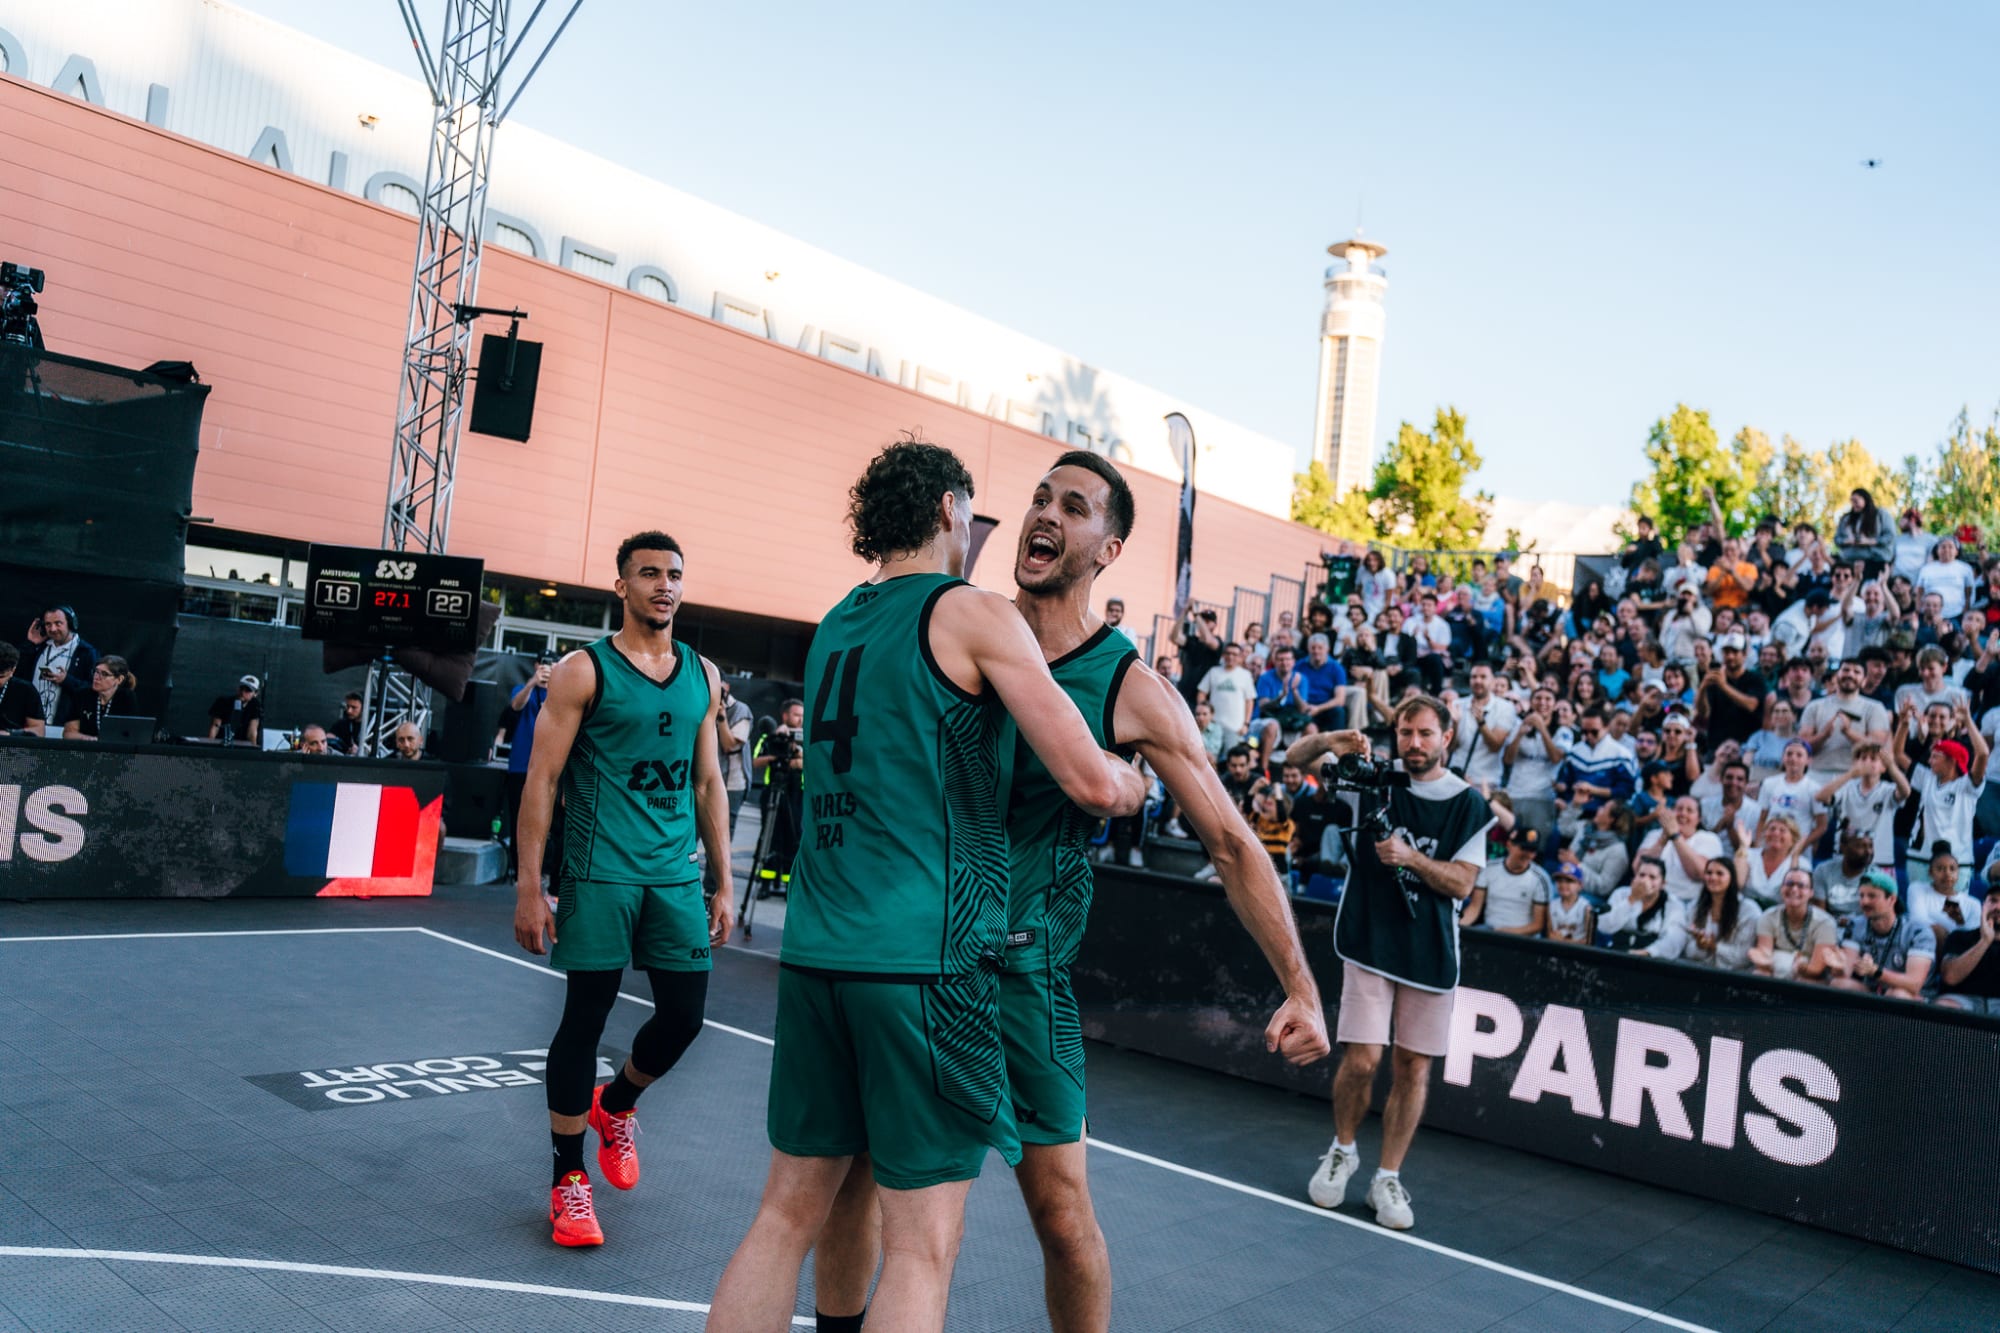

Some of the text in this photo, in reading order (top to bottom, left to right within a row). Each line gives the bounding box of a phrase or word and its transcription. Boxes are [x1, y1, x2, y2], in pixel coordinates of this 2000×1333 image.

[320, 569, 360, 578] AMSTERDAM
[440, 579, 460, 587] PARIS
[324, 584, 351, 604] 16
[374, 591, 411, 609] 27.1
[434, 593, 463, 614] 22
[810, 644, 866, 775] 4
[658, 711, 672, 737] 2
[647, 797, 679, 809] PARIS
[811, 791, 857, 821] ARIS
[815, 823, 844, 850] RA
[300, 1055, 502, 1089] COURT
[1443, 986, 1842, 1167] PARIS
[325, 1069, 543, 1103] ENLIO
